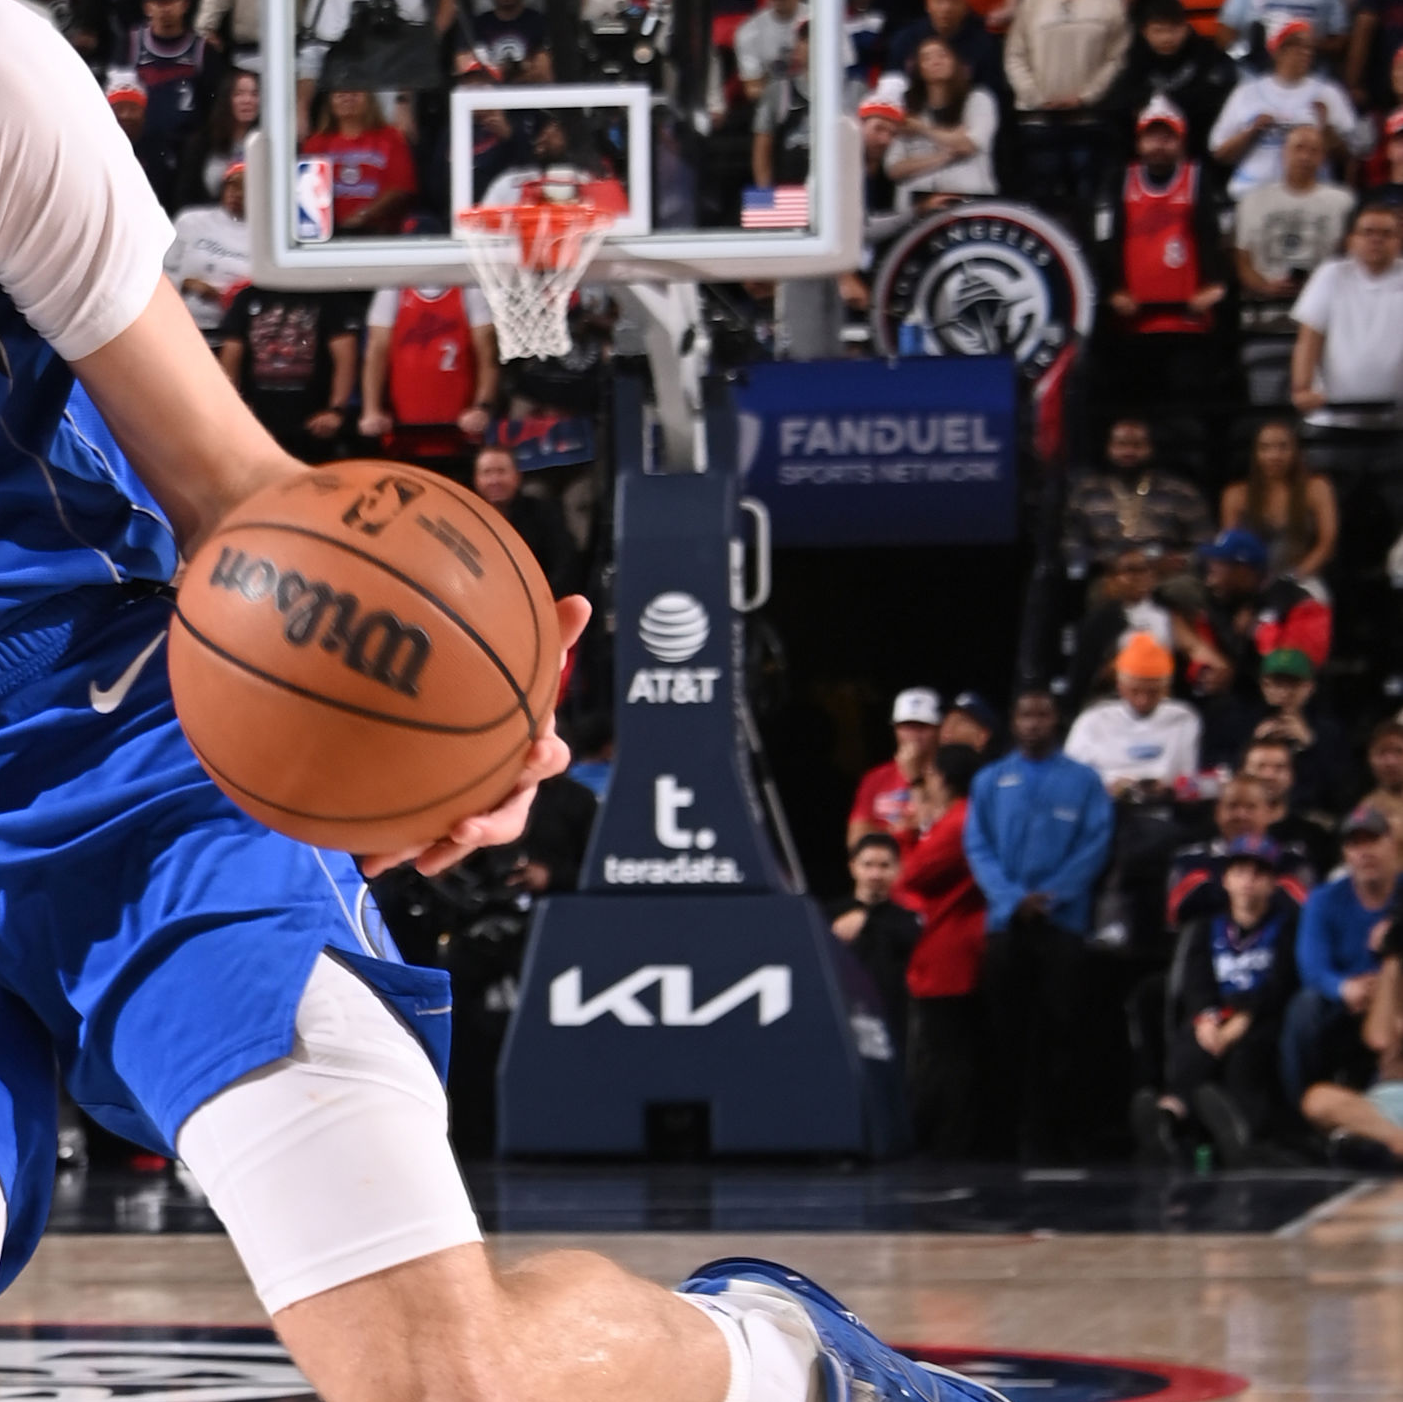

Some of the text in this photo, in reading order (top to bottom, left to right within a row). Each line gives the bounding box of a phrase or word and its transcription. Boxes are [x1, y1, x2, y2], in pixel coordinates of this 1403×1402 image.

[779, 414, 1001, 456] FANDUEL
[210, 546, 432, 698] Wilson
[627, 667, 722, 704] AT&T
[549, 964, 792, 1026] KIA
